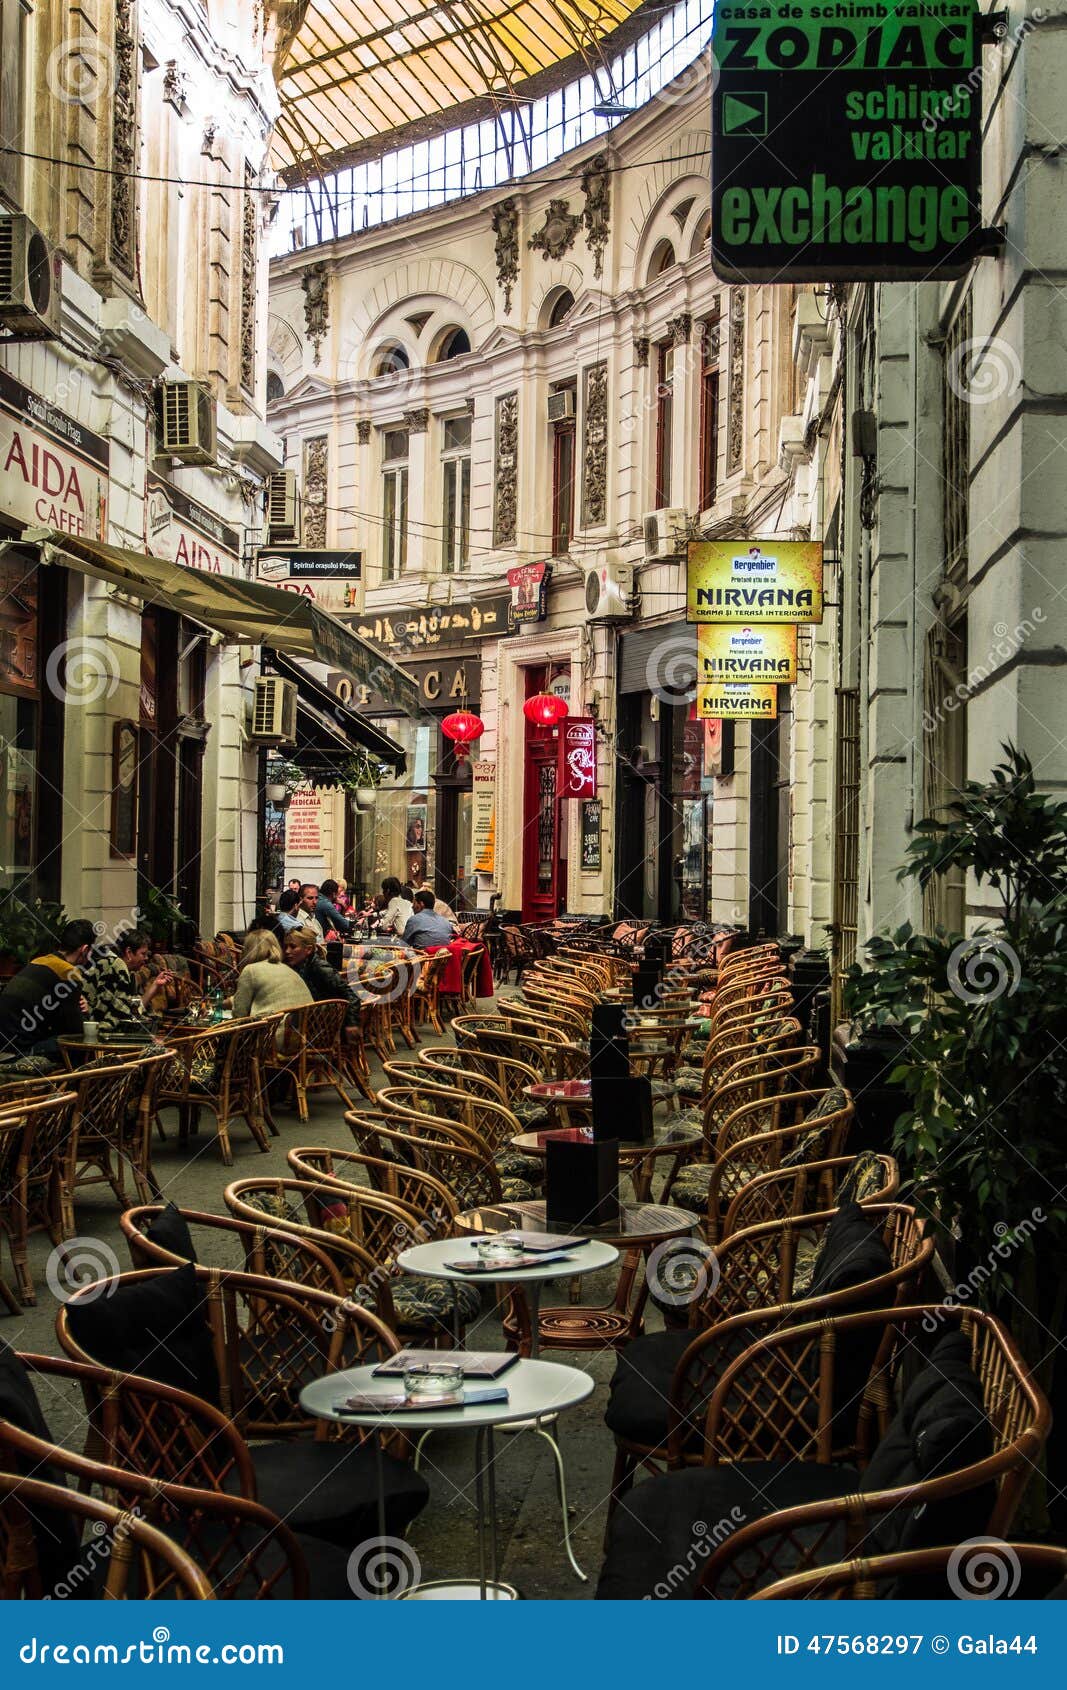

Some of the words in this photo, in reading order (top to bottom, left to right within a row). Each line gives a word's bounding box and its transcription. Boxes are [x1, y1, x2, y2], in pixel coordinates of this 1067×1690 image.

[720, 5, 772, 20] casa
[778, 4, 804, 19] de
[810, 3, 887, 18] schimb
[895, 2, 971, 17] valutar
[720, 24, 968, 69] ZODIAC
[845, 84, 971, 120] schimb
[851, 125, 971, 161] valutar
[720, 173, 970, 253] exchange
[4, 431, 85, 512] AIDA
[293, 562, 314, 570] Spiritul
[734, 560, 776, 571] Bergenbier
[696, 588, 813, 608] NIRVANA
[731, 637, 762, 646] Bergenbier
[703, 658, 790, 673] NIRVANA
[703, 697, 772, 710] NIRVANA
